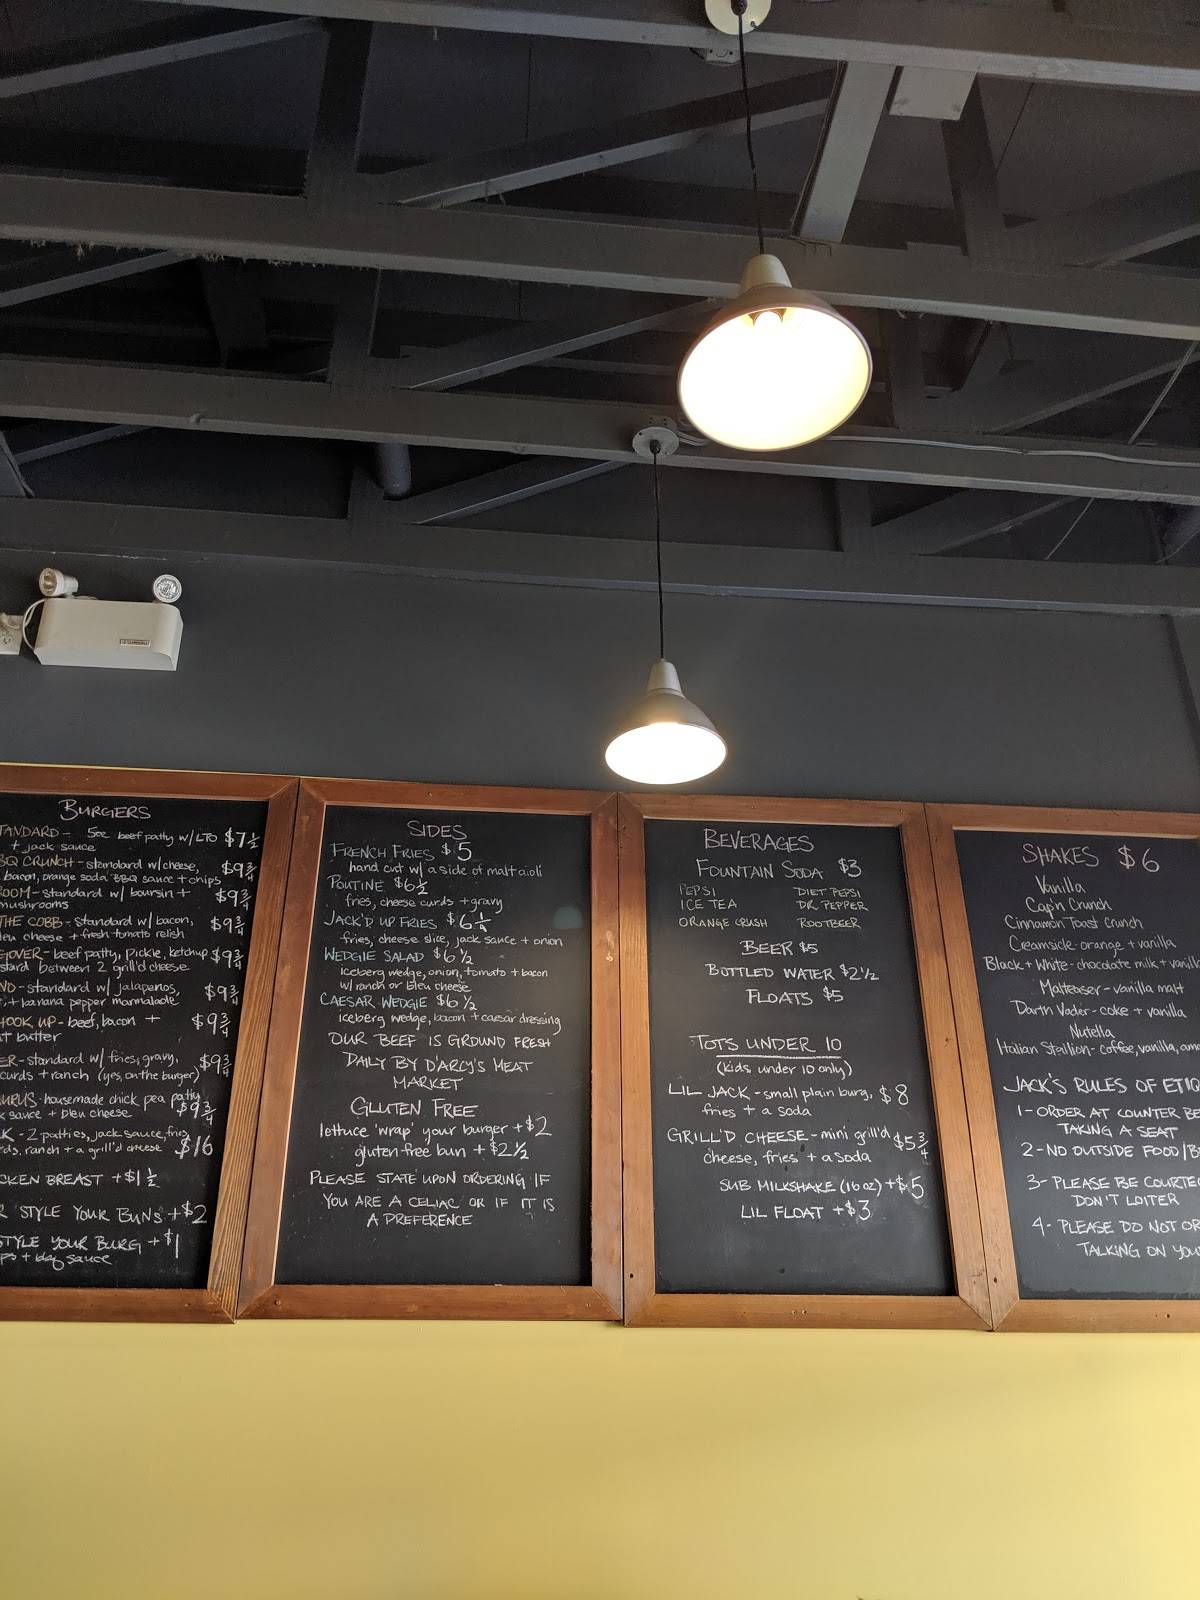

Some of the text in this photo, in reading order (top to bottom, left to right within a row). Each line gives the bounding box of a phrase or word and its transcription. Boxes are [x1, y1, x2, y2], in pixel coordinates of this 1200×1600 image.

[59, 799, 151, 820] BURGERS
[407, 820, 468, 840] SIDES
[22, 840, 54, 853] jack
[61, 843, 96, 852] sauce
[704, 828, 814, 852] BEVERAGES
[330, 843, 387, 859] FRENCH
[392, 844, 435, 860] FRIES
[1023, 844, 1099, 867] SHAKES
[349, 861, 378, 872] hand
[384, 863, 404, 873] cut
[409, 861, 422, 876] w/
[472, 865, 482, 875] of
[487, 865, 515, 876] malt
[696, 858, 862, 879] FOUNTAIN SODA $3
[4, 871, 39, 884] bacon,
[43, 874, 77, 887] orange
[81, 872, 107, 882] soda
[142, 874, 174, 884] sauce
[327, 876, 384, 893] POUTINE
[1035, 875, 1085, 895] Vanilla
[793, 887, 861, 898] DIET PEPSI
[680, 900, 737, 910] ICE TEA
[822, 901, 869, 911] PEPPER
[1069, 898, 1112, 911] Crunch
[679, 917, 768, 930] ORANGE CRUSH
[796, 917, 862, 929] ROOTBEER
[1005, 914, 1065, 930] Cinnamon
[1062, 916, 1098, 929] Toast
[340, 934, 374, 947] fries,
[379, 934, 418, 943] cheese
[424, 934, 449, 946] slice,
[454, 935, 481, 948] jack
[485, 935, 516, 945] sauce
[534, 936, 563, 946] onion
[740, 940, 818, 956] BEER $5
[39, 962, 89, 974] between
[98, 962, 107, 971] 2
[149, 961, 190, 971] cheese
[705, 964, 835, 981] BOTTLED WATER
[746, 986, 844, 1006] FLOATS $5
[1113, 982, 1184, 994] vanilla malt
[21, 997, 180, 1012] banana pepper marmalade
[1100, 1004, 1128, 1017] coke
[1147, 1003, 1187, 1018] vanilla
[328, 1032, 551, 1048] OUR BEEF IS GROUND FRESH
[1070, 1024, 1116, 1040] Nutella
[689, 1035, 842, 1052] TOTS UNDER 10
[142, 1054, 179, 1068] gravy,
[343, 1051, 534, 1074] DAILY BY D'ARCY'S MEAT
[716, 1060, 852, 1083] (kids under 10 only)
[393, 1076, 464, 1090] MARKET
[1003, 1073, 1157, 1094] JACK'S RULES OF
[109, 1092, 141, 1106] chick
[144, 1094, 165, 1110] pea
[171, 1089, 200, 1108] patty
[350, 1096, 479, 1118] GLUTEN FREE
[1090, 1107, 1181, 1119] AT COUNTER
[320, 1123, 370, 1137] lettuce
[423, 1126, 455, 1144] your
[463, 1124, 508, 1141] burger
[1057, 1123, 1179, 1139] TAKING A SEAT
[175, 1135, 213, 1159] $16
[1072, 1145, 1133, 1157] OUTSIDE
[703, 1149, 757, 1166] cheese,
[763, 1151, 798, 1164] fries
[807, 1153, 817, 1162] +
[46, 1173, 103, 1186] BREAST
[310, 1170, 551, 1189] PLEASE STATE UPON ORDERING IF
[720, 1179, 751, 1192] SUB
[757, 1181, 836, 1194] MILKSHAKE
[1052, 1175, 1138, 1190] PLEASE BE
[1071, 1193, 1179, 1207] DON'T LOITER
[20, 1206, 61, 1221] STYLE
[73, 1205, 110, 1221] YOUR
[116, 1208, 163, 1224] BUNS
[367, 1212, 473, 1227] A PREFERENCE
[741, 1204, 767, 1219] LIL
[774, 1205, 824, 1219] FLOAT
[1057, 1219, 1177, 1234] PLEASE DO NOT
[50, 1235, 88, 1250] YOUR
[94, 1236, 141, 1254] BURG
[1076, 1242, 1166, 1258] TALKING ON
